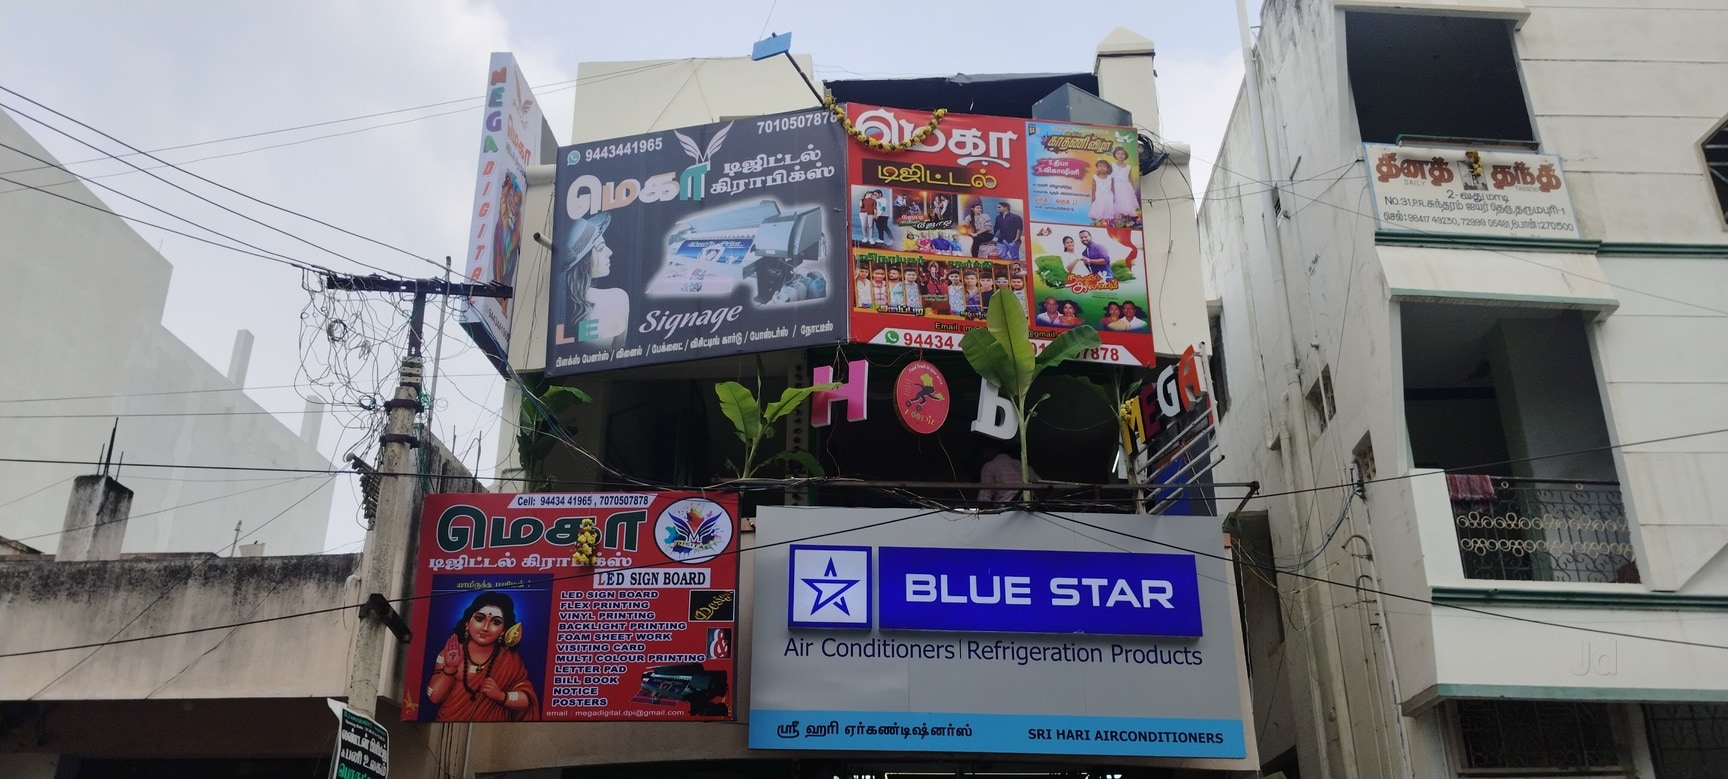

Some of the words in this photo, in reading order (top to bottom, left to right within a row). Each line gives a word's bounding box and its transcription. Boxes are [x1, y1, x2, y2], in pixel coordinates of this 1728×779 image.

[483, 66, 507, 153] MEGA
[757, 112, 838, 135] 7010507878
[855, 108, 1018, 168] மெகா
[585, 137, 663, 162] 9443441965
[723, 144, 822, 175] டிஜிட்டல்
[710, 162, 835, 196] கிராபிக்ஸ்
[877, 163, 998, 189] டிஜிட்டல்
[1404, 178, 1426, 186] DAILY
[566, 163, 711, 220] மெகா
[468, 160, 495, 304] DIGITA
[639, 305, 744, 339] Signage
[935, 321, 958, 332] Email
[903, 332, 954, 350] 94434
[811, 359, 868, 428] H
[1122, 344, 1200, 456] MEGA
[517, 495, 536, 507] Cell:
[540, 495, 565, 507] 94434
[566, 495, 592, 507] 41965
[599, 495, 649, 507] 7070507878
[436, 504, 648, 553] மெகா
[428, 553, 517, 571] டிஜிட்டல்
[596, 571, 625, 587] LED
[629, 571, 662, 586] SIGN
[663, 571, 706, 586] BOARD
[561, 590, 584, 599] LED
[586, 590, 617, 599] SIGN
[619, 590, 659, 599] BOARD
[905, 573, 1031, 605] BLUE
[1050, 577, 1174, 609] STAR
[560, 601, 588, 610] FLEX
[593, 601, 649, 610] PRINTING
[559, 611, 596, 620] VINYL
[598, 611, 655, 620] PRINTING
[558, 622, 626, 631] BACKLIGHT
[629, 622, 687, 631] PRINTING
[557, 632, 589, 641] FOAM
[594, 632, 632, 641] SHEET
[635, 632, 672, 641] WORK
[556, 643, 608, 652] VISITING
[612, 643, 645, 652] CARD
[784, 637, 814, 657] Air
[821, 637, 955, 660] Conditioners
[967, 640, 1102, 666] Refrigeration
[1112, 643, 1203, 666] Products
[555, 653, 593, 663] MULTI
[595, 653, 647, 663] COLOUR
[648, 653, 705, 663] PRINTING
[554, 664, 601, 674] LETTER
[603, 664, 627, 674] PAD
[554, 675, 580, 685] BILL
[583, 675, 618, 685] BOOK
[553, 686, 599, 696] NOTICE
[552, 698, 608, 707] POSTERS
[546, 709, 568, 717] email
[575, 708, 684, 718] megadigital.dpi@gmail.com
[805, 719, 839, 737] ஹரி
[1028, 728, 1052, 740] SRI
[1056, 729, 1090, 741] HARI
[1095, 730, 1224, 744] AIRCONDITIONERS
